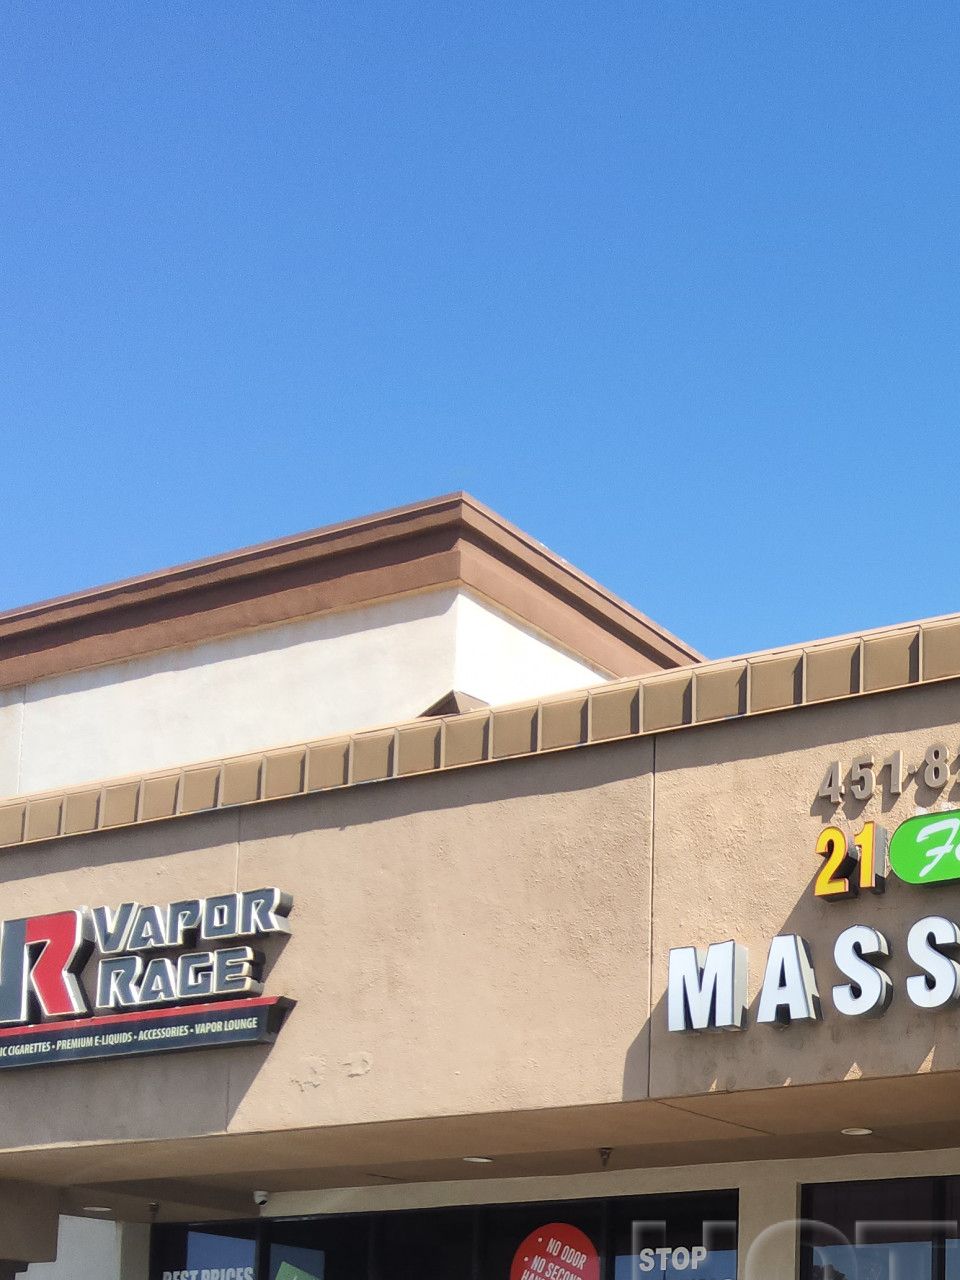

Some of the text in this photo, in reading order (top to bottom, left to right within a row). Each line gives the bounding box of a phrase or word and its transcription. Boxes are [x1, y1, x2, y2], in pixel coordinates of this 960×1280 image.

[814, 821, 884, 899] 21
[92, 887, 290, 953] VAPOR
[96, 946, 258, 1008] RAGE
[8, 1041, 51, 1056] CIGARETTES
[56, 1036, 93, 1051] PREMIUM
[94, 1032, 133, 1047] E-LIQUIDS
[138, 1024, 189, 1041] ACCESSORIES
[195, 1021, 223, 1035] VAPOR
[224, 1017, 258, 1032] LOUNGE
[531, 1255, 545, 1273] NO
[546, 1237, 587, 1270] NO ODOR
[639, 1246, 707, 1272] STOP
